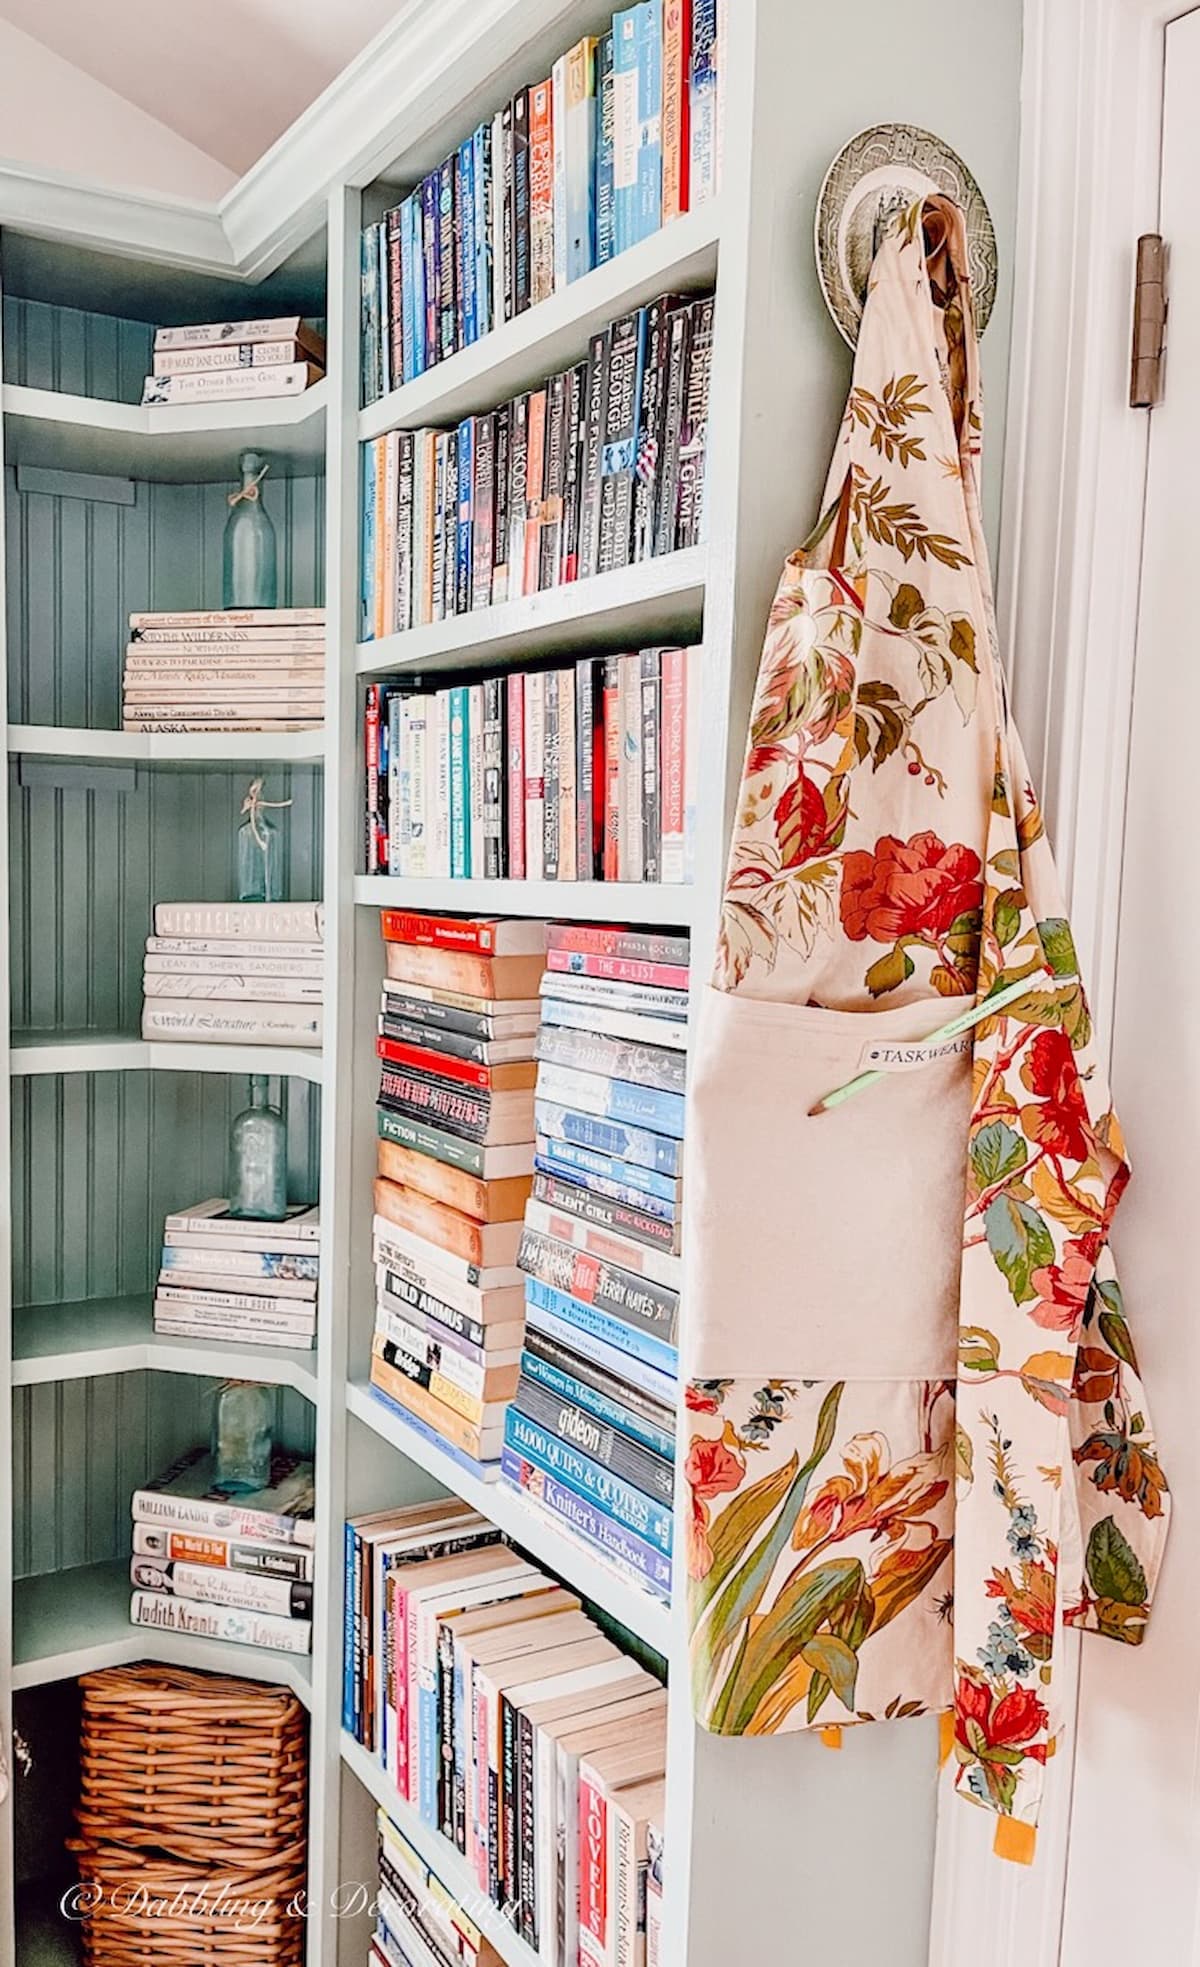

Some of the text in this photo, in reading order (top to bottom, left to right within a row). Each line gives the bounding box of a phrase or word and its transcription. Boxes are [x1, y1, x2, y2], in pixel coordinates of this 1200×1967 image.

[440, 247, 454, 308] BROWN
[587, 363, 603, 480] VINCE FLYNN
[607, 356, 623, 435] GEORGE
[619, 353, 636, 428] Elizabeth
[566, 374, 581, 482] SEABISCUIT
[511, 451, 527, 522] KOONTZ
[680, 465, 696, 529] GAME
[600, 500, 616, 568] DEATH
[613, 480, 628, 564] THIS BODY
[140, 723, 190, 733] ALASKA
[670, 703, 683, 826] NORA ROBERTS
[598, 959, 656, 979] THE A-LIST
[383, 1118, 417, 1143] FICTION
[551, 1190, 613, 1224] SILENT GIRLS
[391, 1276, 465, 1333] WILD ANIMUS
[601, 1273, 654, 1318] TERRY HAYES
[558, 1406, 600, 1453] gideon
[138, 1499, 175, 1519] WILLIAM
[549, 1443, 583, 1479] QUIPS
[596, 1475, 649, 1523] QUOTES
[545, 1480, 597, 1536] Knitter's
[599, 1521, 648, 1571] Handbook
[137, 1596, 292, 1649] Judith Krantz Lovers
